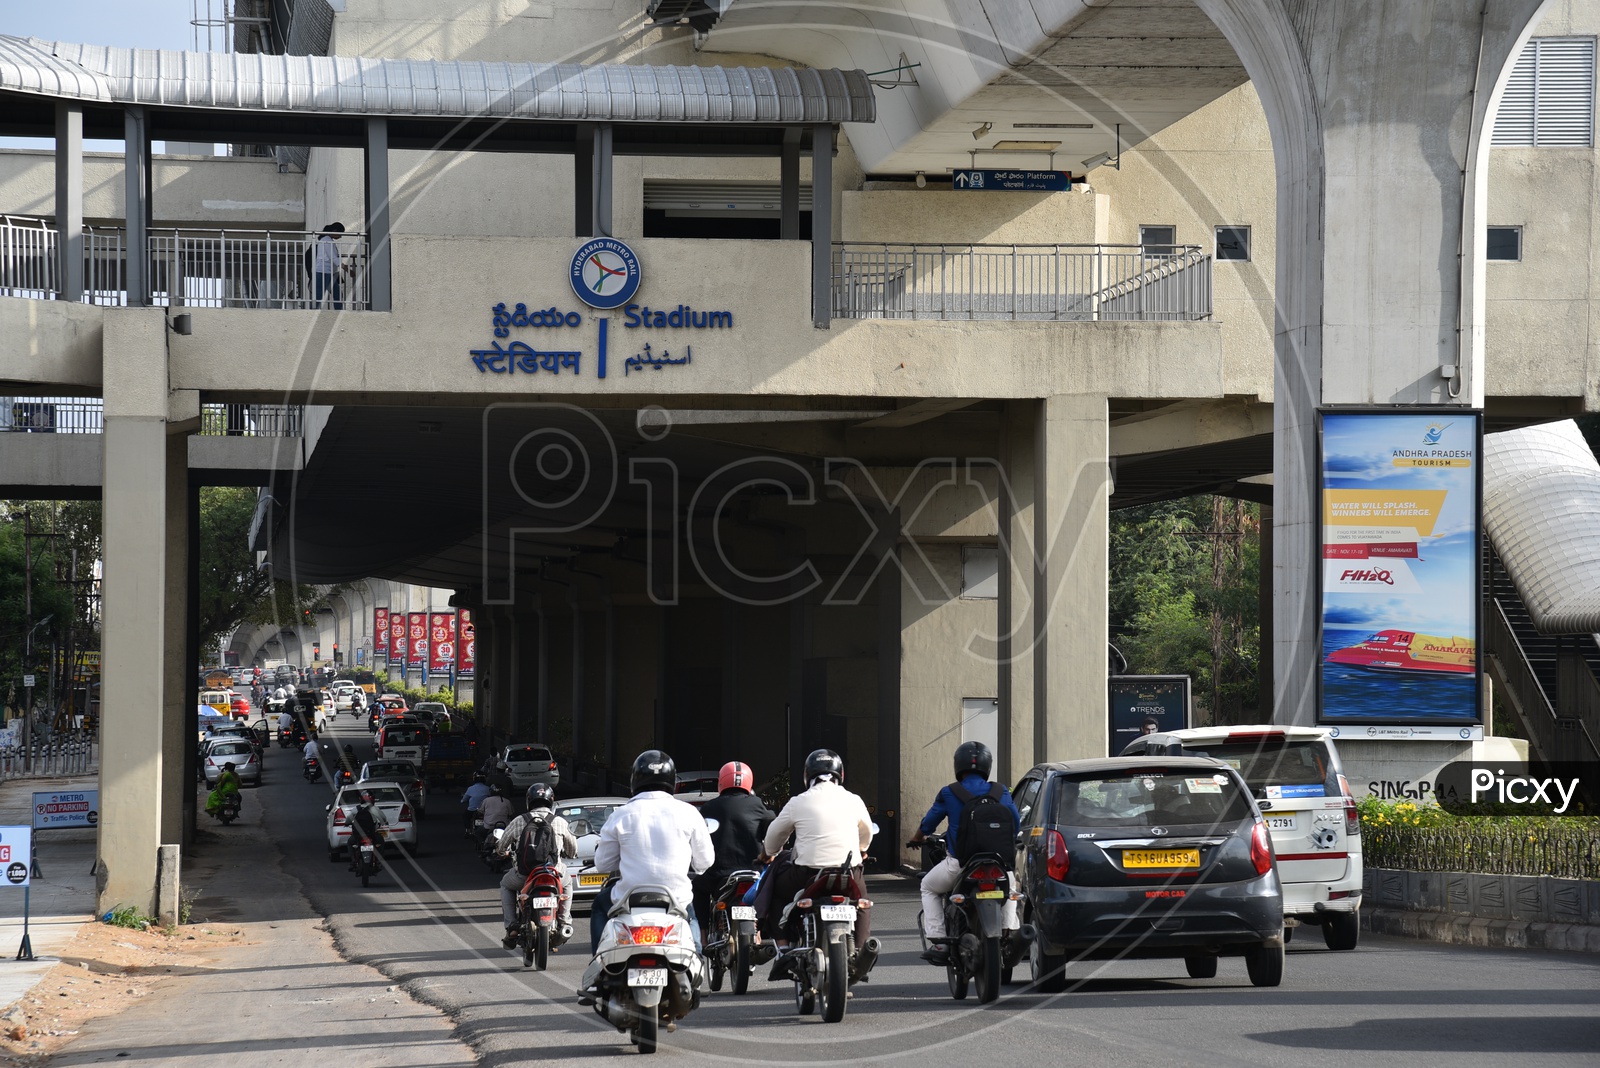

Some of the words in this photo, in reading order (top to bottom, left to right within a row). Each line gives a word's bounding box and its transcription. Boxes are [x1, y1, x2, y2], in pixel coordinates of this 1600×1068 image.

[1026, 172, 1056, 180] Platform
[574, 242, 604, 276] HYDERABAD
[606, 242, 630, 259] METRO
[627, 258, 637, 276] RAIL
[624, 304, 733, 329] Stadium
[470, 340, 582, 375] स्टेडियम
[1392, 449, 1429, 458] ANDHRA
[1431, 449, 1472, 458] PRADESH
[1412, 459, 1451, 467] TOURISM
[1331, 502, 1359, 510] WATER
[1331, 509, 1371, 517] WINNERS
[1397, 634, 1409, 642] 14
[60, 794, 84, 802] METRO
[58, 803, 88, 812] PARKING
[1273, 818, 1293, 828] 2791
[1129, 853, 1196, 865] TS16UA9594
[1145, 891, 1170, 899] MOTOR
[1171, 890, 1186, 898] CAB
[636, 977, 641, 985] A
[643, 977, 664, 985] 7671
